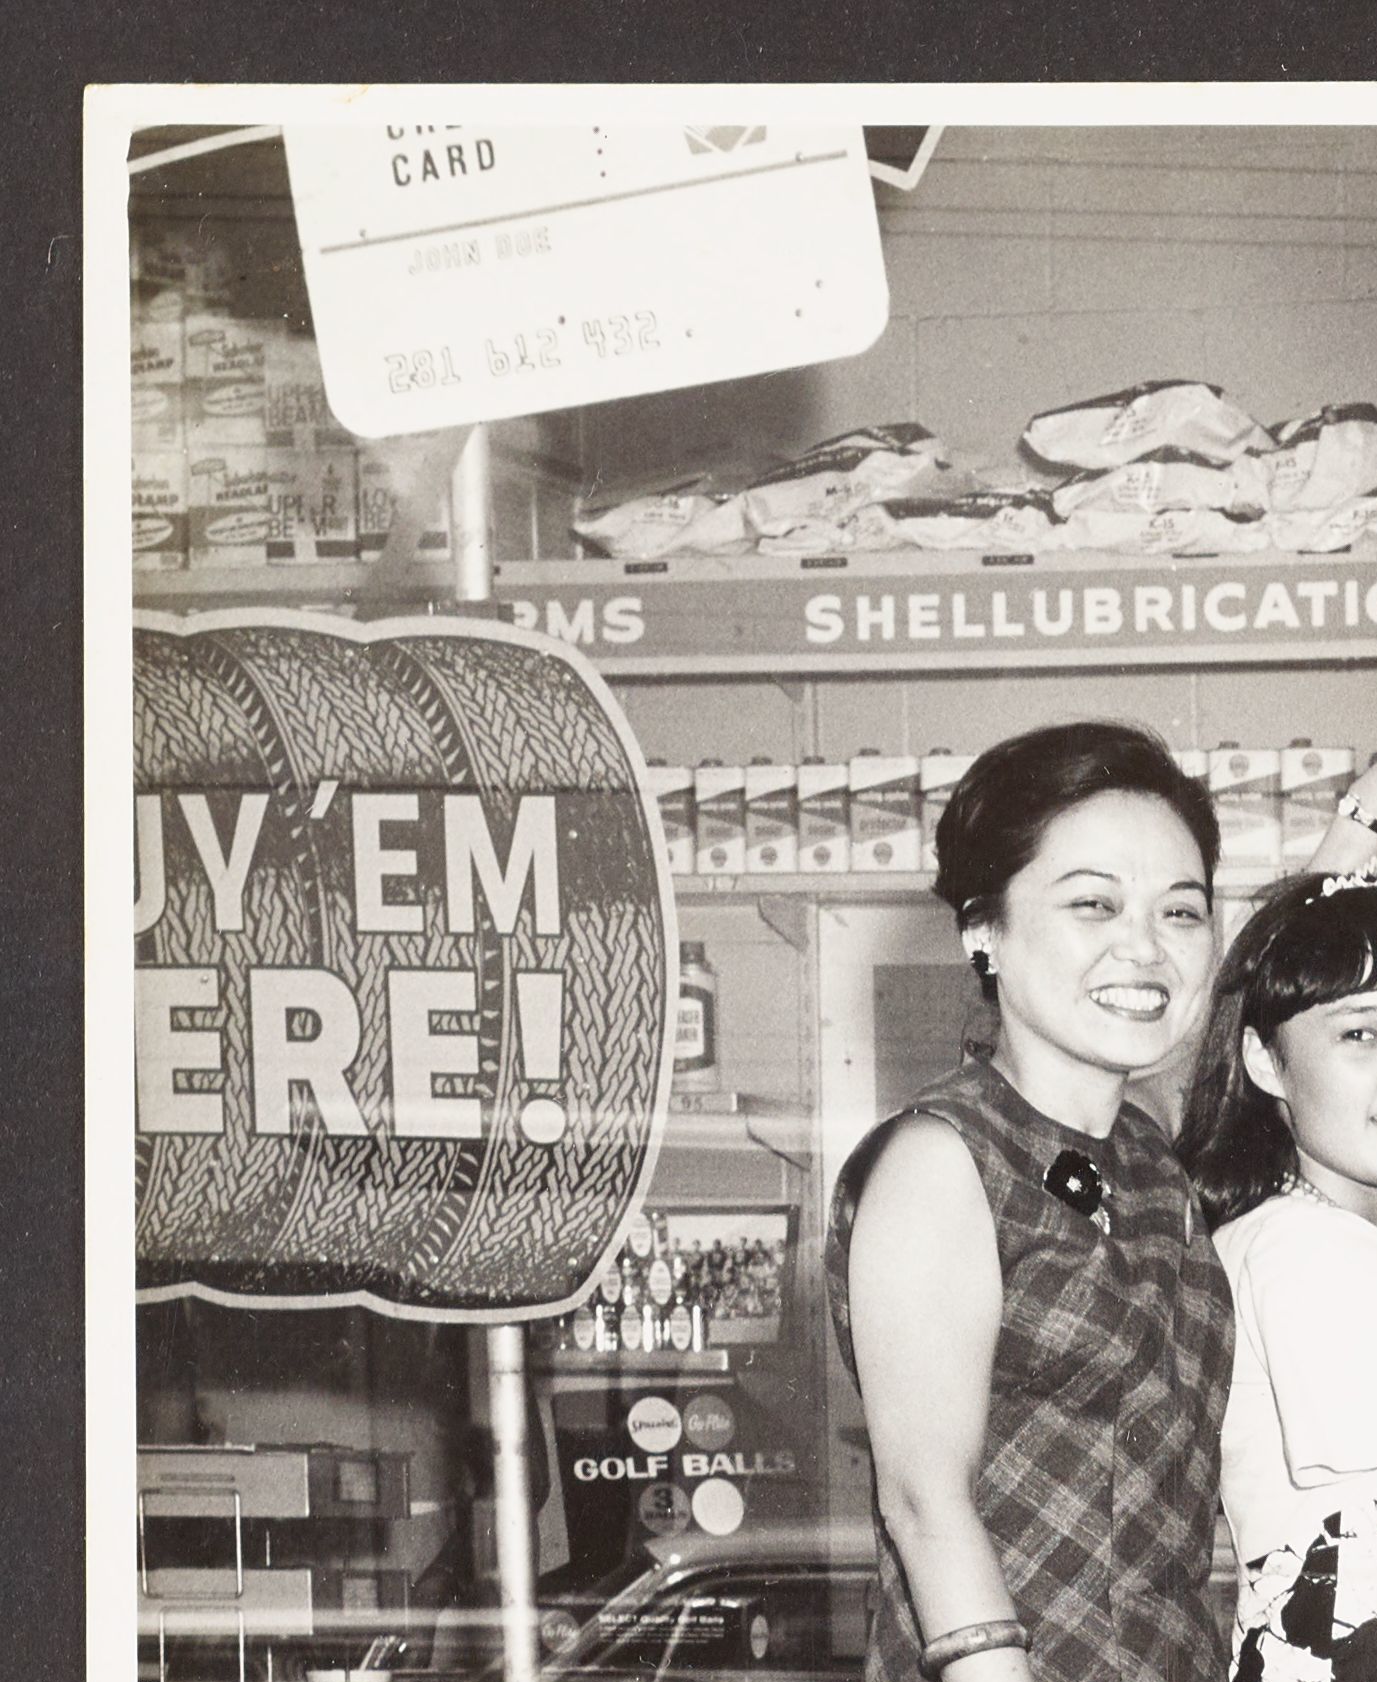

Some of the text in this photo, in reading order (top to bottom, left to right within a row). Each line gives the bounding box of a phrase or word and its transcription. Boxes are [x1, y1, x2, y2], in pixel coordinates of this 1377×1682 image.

[392, 139, 495, 186] CARD
[135, 966, 568, 1144] ERE!
[574, 1453, 795, 1482] GOLF BALLS
